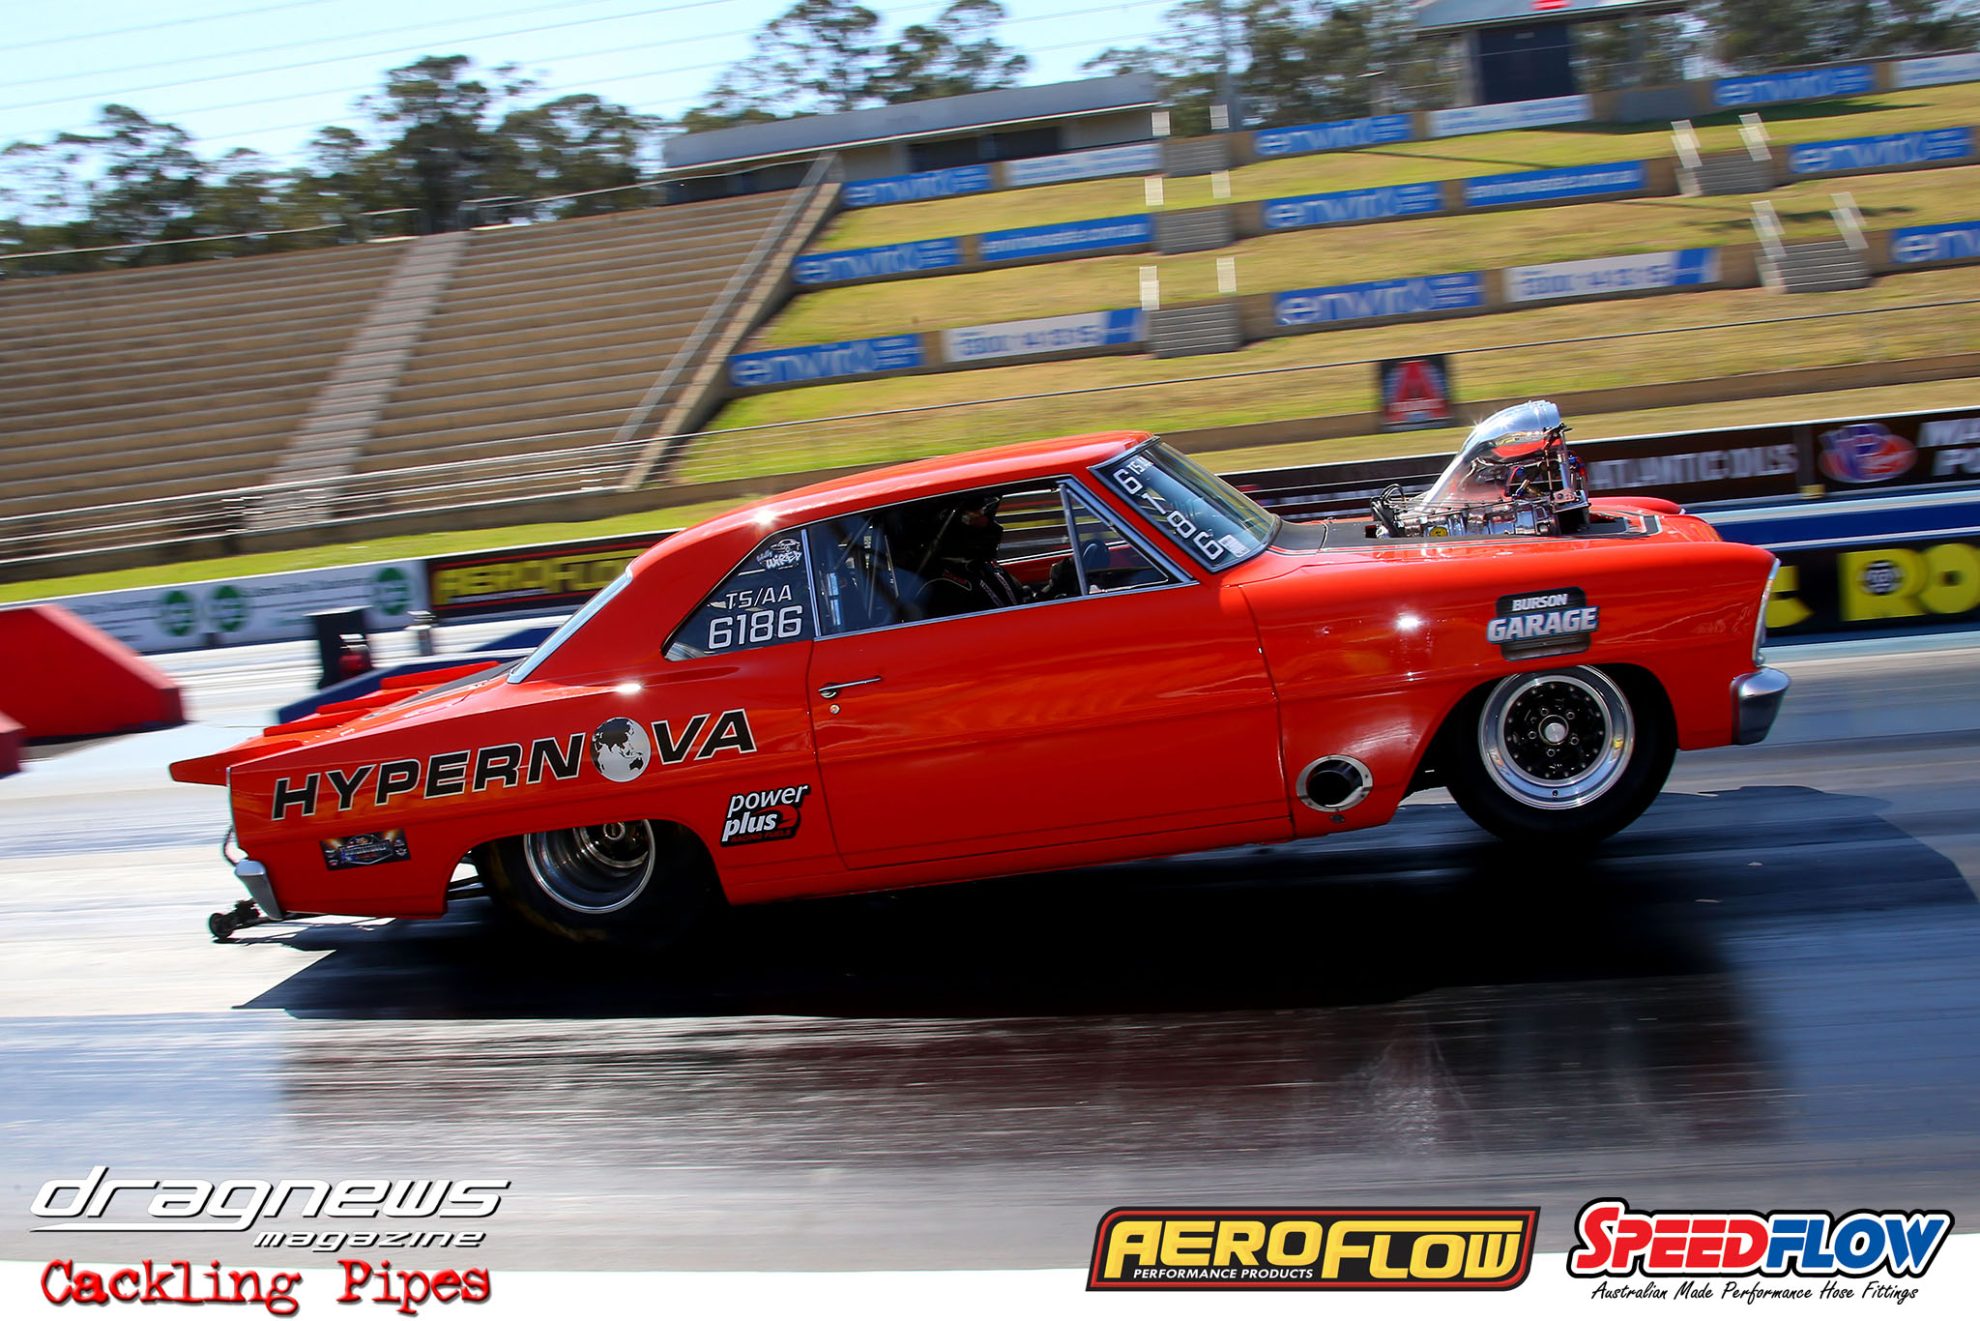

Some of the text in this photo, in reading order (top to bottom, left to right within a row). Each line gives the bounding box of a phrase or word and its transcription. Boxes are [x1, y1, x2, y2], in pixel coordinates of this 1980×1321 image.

[1112, 468, 1224, 561] 6186
[725, 584, 793, 610] TS/AA
[1511, 593, 1569, 612] BURSON
[708, 605, 803, 650] 6186
[1486, 606, 1599, 643] GARAGE
[726, 784, 809, 819] power
[721, 811, 778, 842] plus
